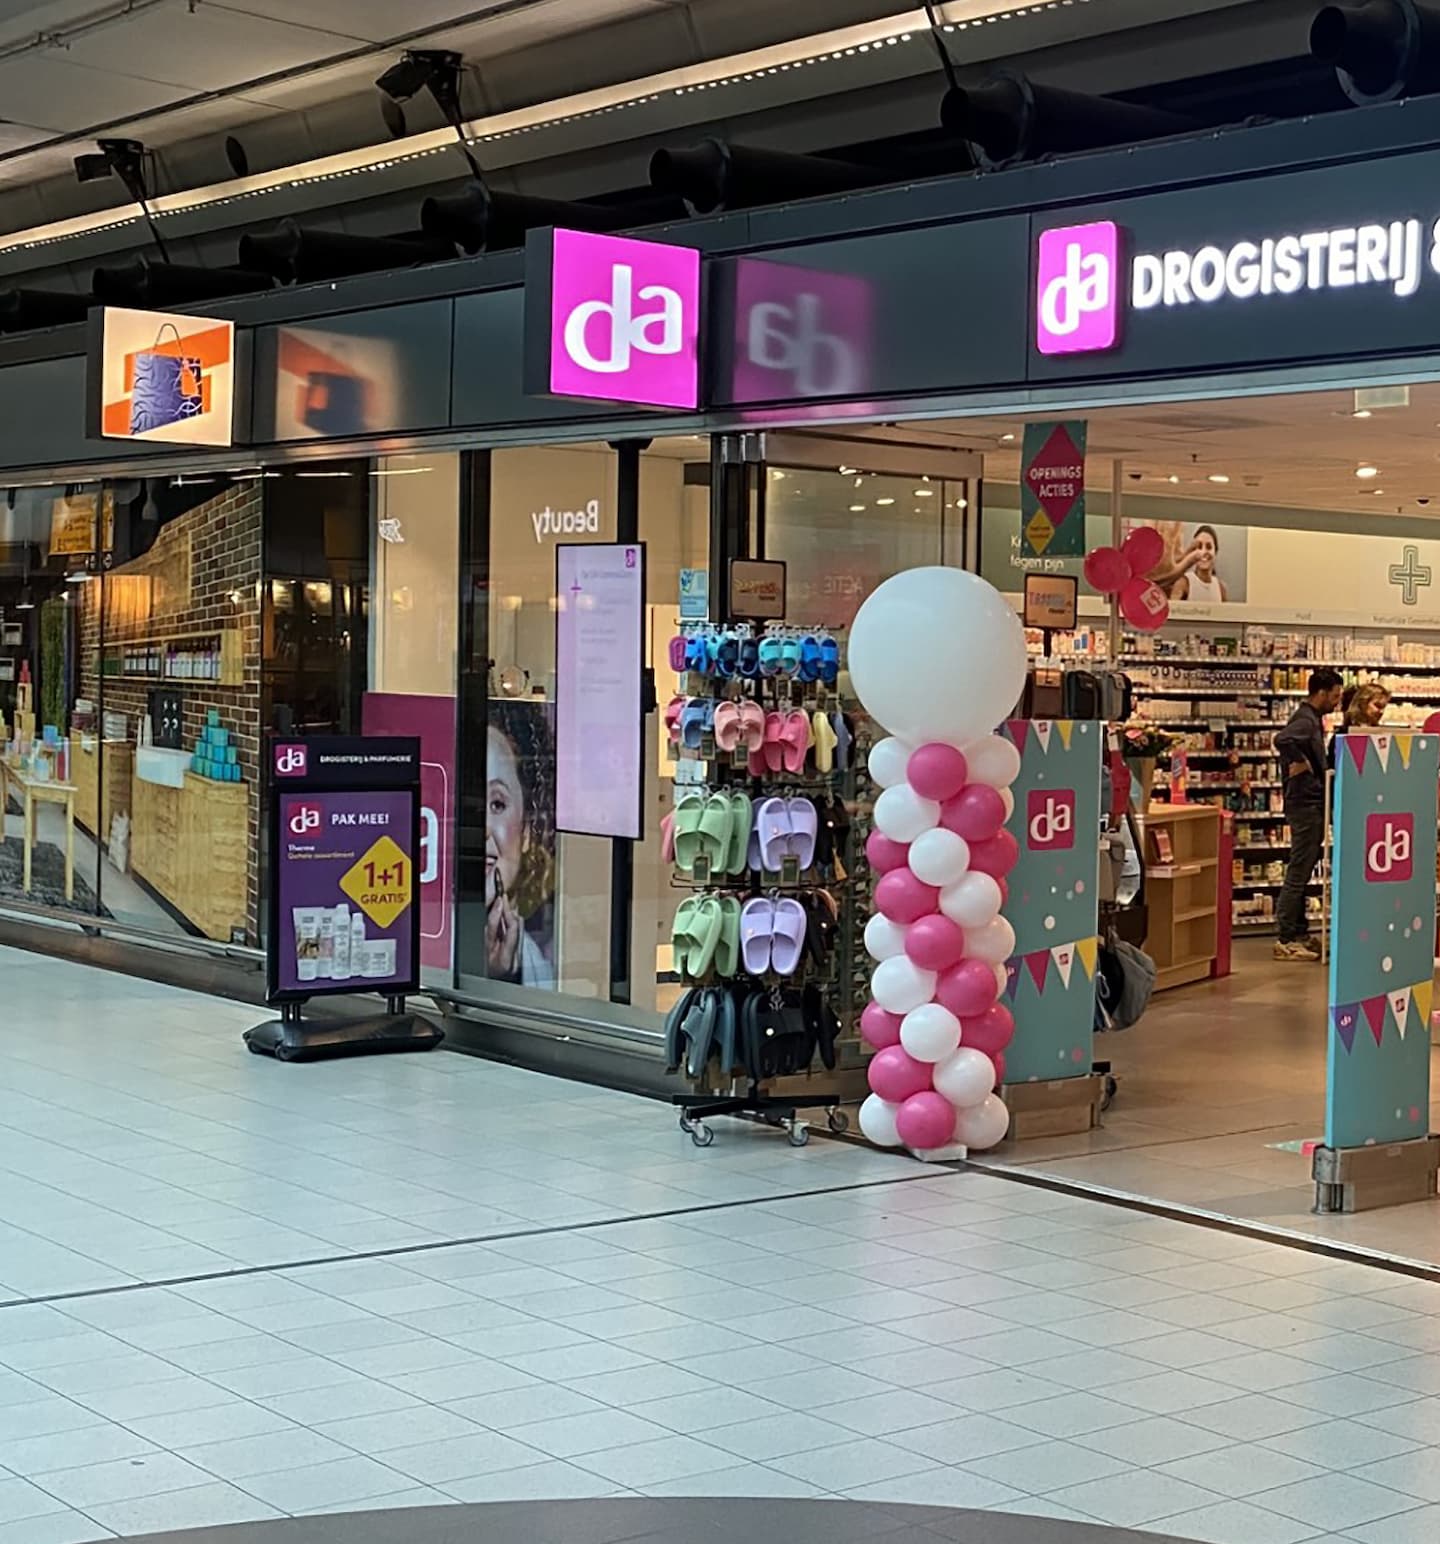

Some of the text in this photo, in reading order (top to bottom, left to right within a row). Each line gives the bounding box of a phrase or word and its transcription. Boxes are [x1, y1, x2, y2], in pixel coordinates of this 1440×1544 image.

[1131, 218, 1422, 308] DROGISTERIJ
[1040, 243, 1110, 336] da
[563, 263, 683, 374] da
[1030, 465, 1082, 480] OPENINGS
[1038, 483, 1075, 498] ACTIES
[276, 748, 305, 773] da
[289, 807, 320, 834] da
[331, 813, 390, 825] PAK MEE!
[1029, 798, 1071, 842] da
[1367, 823, 1411, 874] da
[363, 860, 404, 889] 1+1
